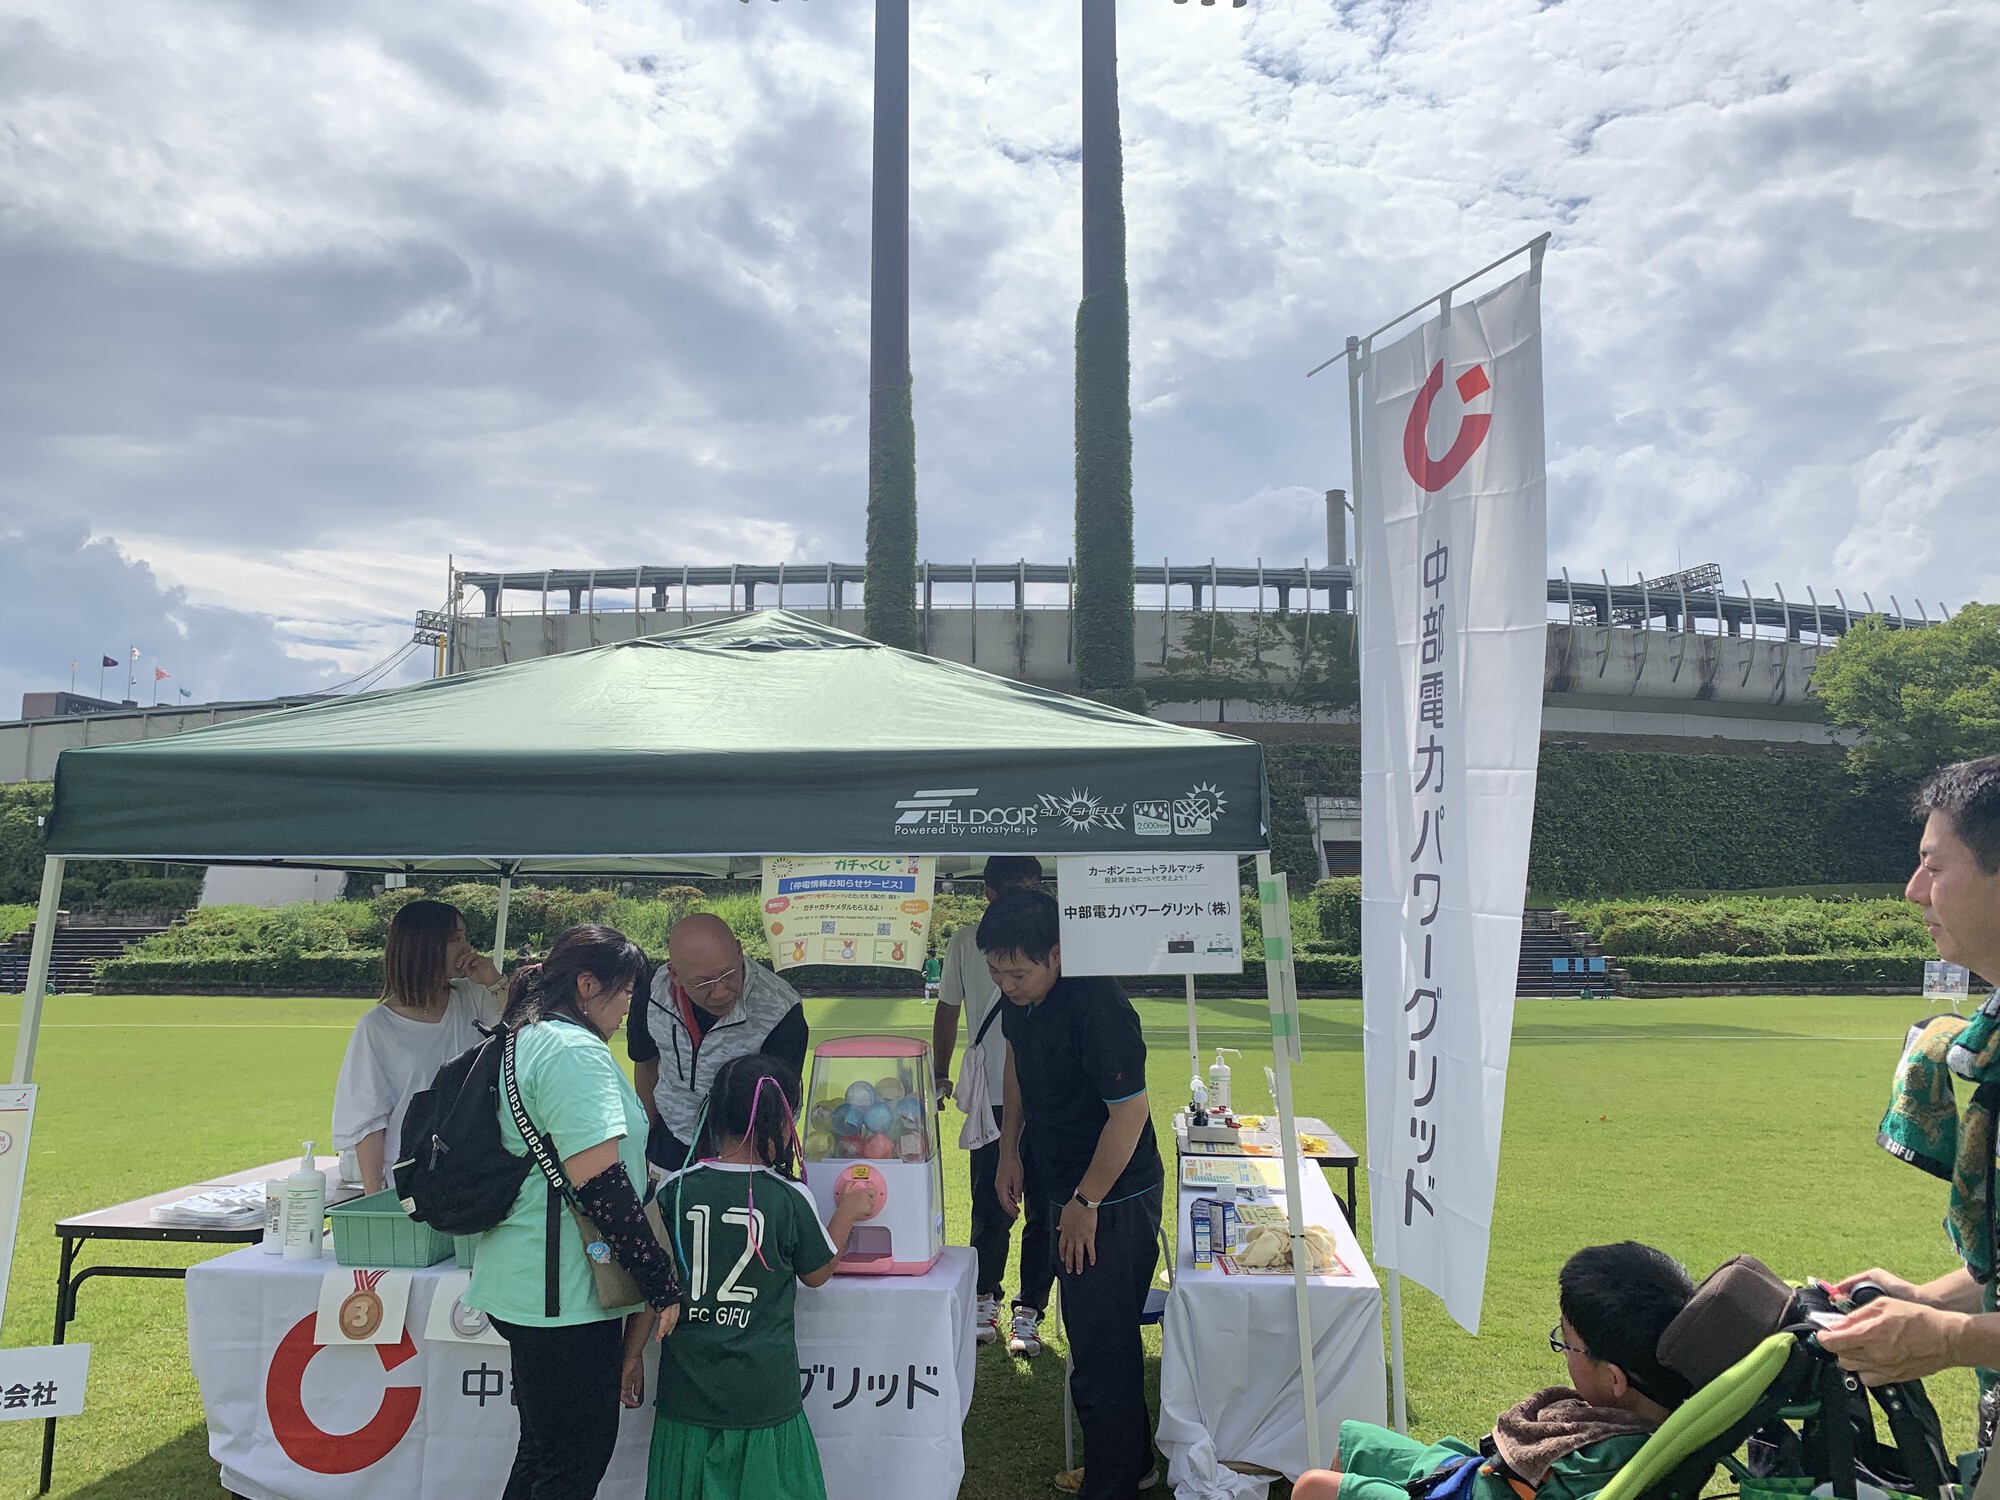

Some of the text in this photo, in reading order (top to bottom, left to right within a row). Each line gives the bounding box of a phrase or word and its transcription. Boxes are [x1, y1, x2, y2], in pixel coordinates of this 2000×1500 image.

[927, 807, 1036, 826] FIELDOOR
[1137, 821, 1170, 831] 2,000mm
[1177, 815, 1200, 828] UV
[894, 823, 1038, 836] Powered by ottostyle.jp
[834, 859, 890, 872] ガチャくじ
[1088, 863, 1205, 877] カーボンニュートラルマッチ
[1404, 539, 1448, 1226] 中部電力パワーグリッド
[686, 1204, 765, 1303] 12
[352, 1301, 370, 1327] 3
[688, 1306, 752, 1329] FC GIFU
[0, 1381, 58, 1409] 会社
